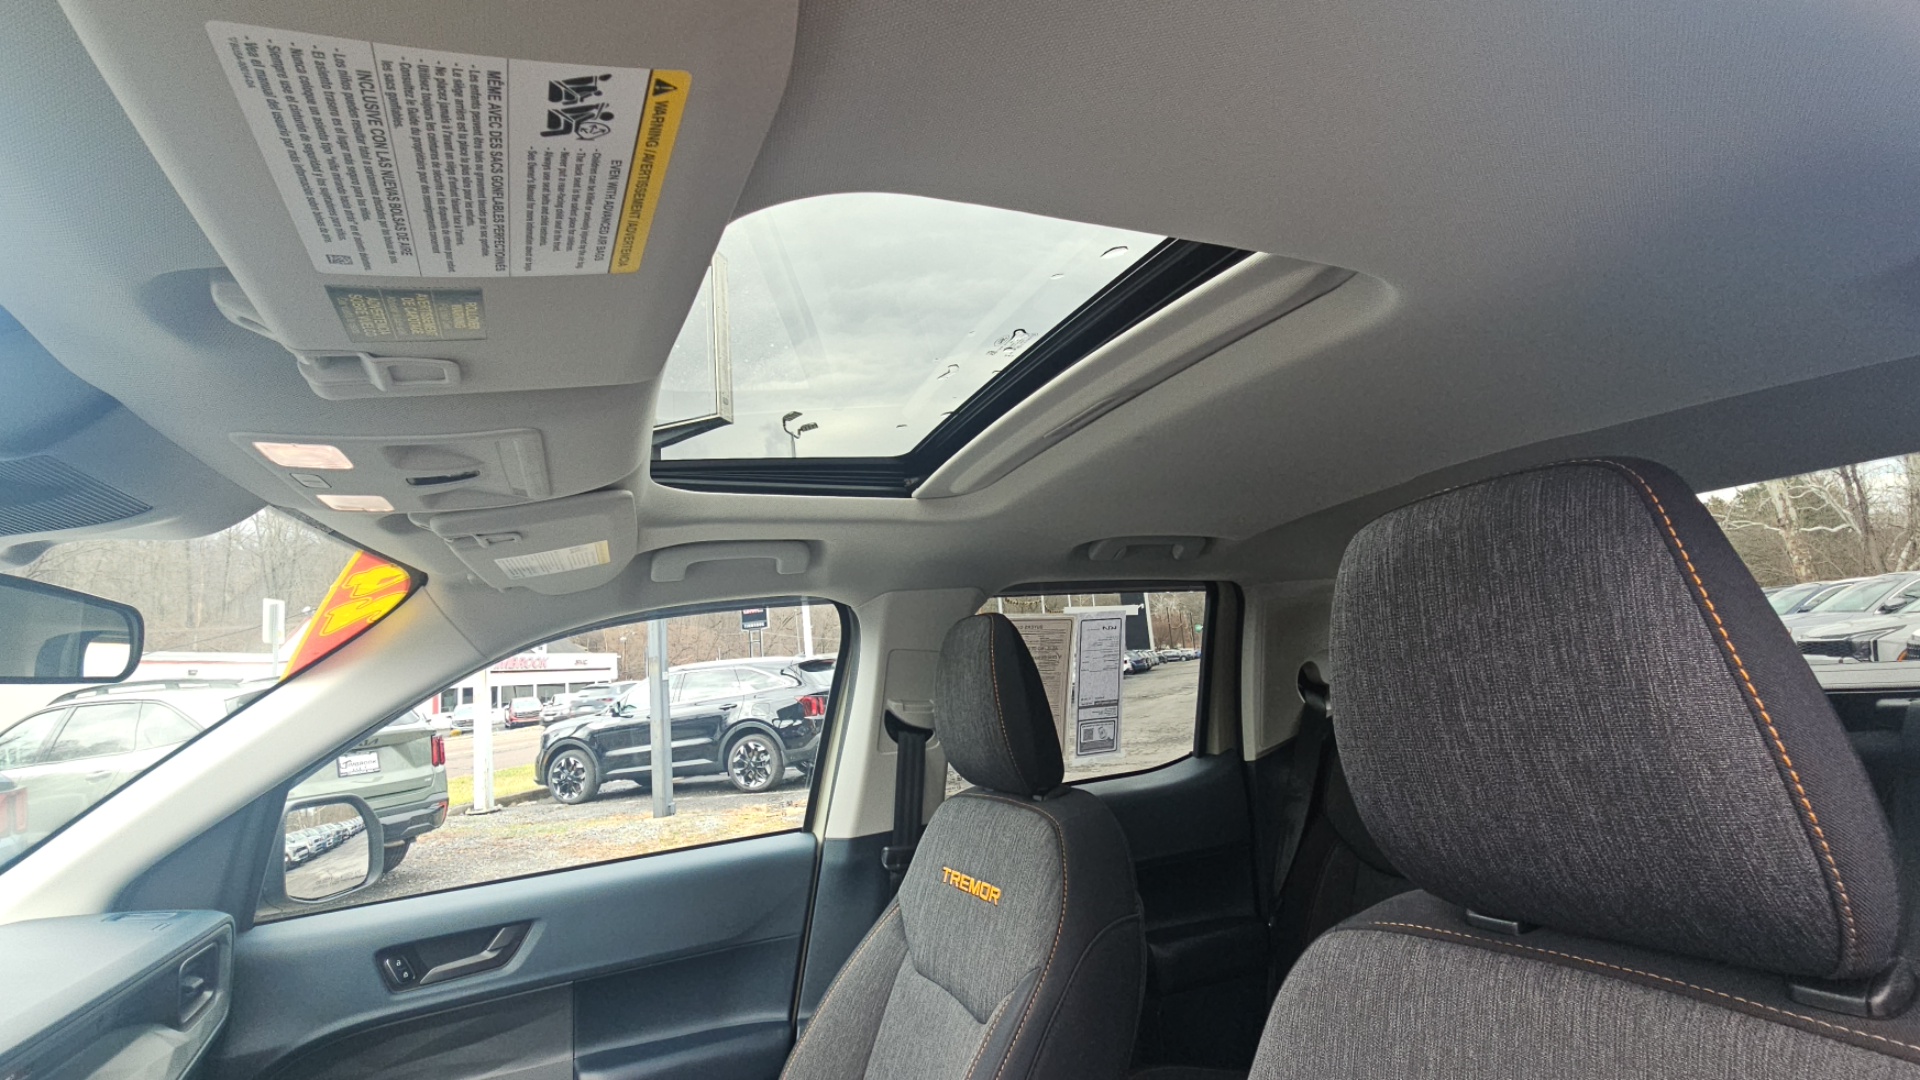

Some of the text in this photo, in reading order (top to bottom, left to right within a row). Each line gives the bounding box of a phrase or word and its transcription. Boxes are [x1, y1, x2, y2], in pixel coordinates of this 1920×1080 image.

[242, 41, 262, 58] Vea
[288, 47, 309, 74] Nunca
[332, 53, 349, 68] Los
[262, 44, 291, 79] Siempre
[278, 79, 294, 94] use
[312, 59, 334, 89] asiento
[380, 59, 394, 72] les
[416, 63, 432, 91] Utilisez
[451, 67, 463, 78] Le
[467, 69, 481, 83] Les
[294, 74, 319, 105] coloque
[336, 68, 354, 91] niños
[398, 61, 417, 98] Consultez
[433, 77, 449, 101] placez
[450, 78, 466, 97] siège
[485, 69, 505, 101] MÊME
[322, 90, 342, 117] trasero
[340, 91, 360, 118] pueden
[418, 91, 436, 121] toujours
[468, 83, 482, 110] enfants
[406, 107, 421, 126] Guide
[436, 101, 452, 123] jamais
[468, 110, 482, 136] peuvent
[487, 101, 502, 129] AVEC
[424, 121, 437, 131] les
[456, 121, 467, 132] est
[456, 140, 470, 156] place
[488, 130, 502, 149] DES
[354, 69, 412, 256] INCLUSIVE CON LAS NUEVAS BOLSAS DE AIRE
[489, 150, 503, 173] SACS
[527, 150, 536, 160] See
[541, 151, 553, 170] Always
[559, 151, 568, 167] Never
[575, 152, 585, 162] The
[617, 99, 669, 266] WARNING AVERTISSEMENT ADVERTENCIA
[490, 175, 504, 222] GONFLABLES
[593, 159, 622, 261] EVEN WITH ADVANCED AIR BAGS
[941, 866, 1002, 906] TREMOR
